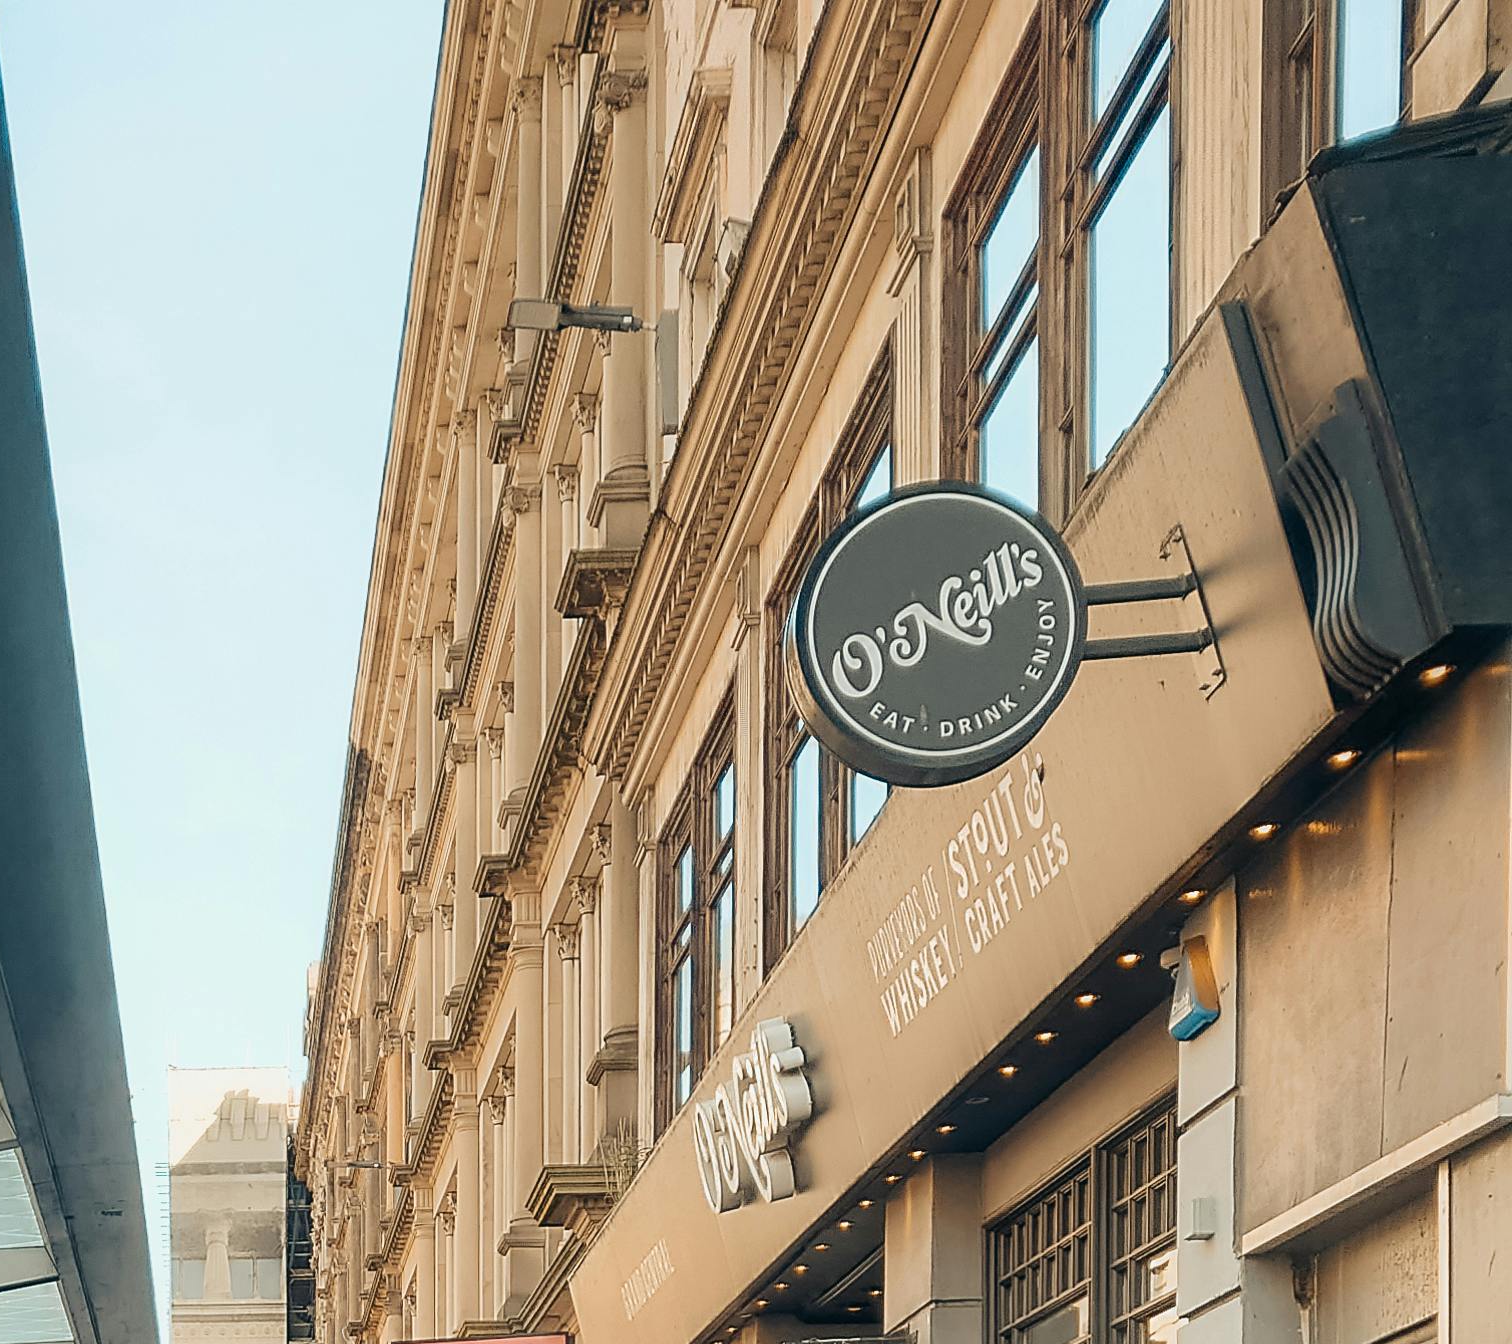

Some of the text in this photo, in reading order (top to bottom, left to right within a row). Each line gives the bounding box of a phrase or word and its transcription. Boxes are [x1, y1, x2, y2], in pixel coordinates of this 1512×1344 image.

[832, 542, 1043, 698] O'Neill's
[869, 599, 1057, 738] EAT DRINK ENJOY
[921, 864, 942, 921] OF
[948, 770, 1024, 900] STOUT
[964, 821, 1069, 954] CRAFT ALES
[880, 923, 957, 1039] WHISKEY
[693, 1016, 790, 1214] O'Neill's
